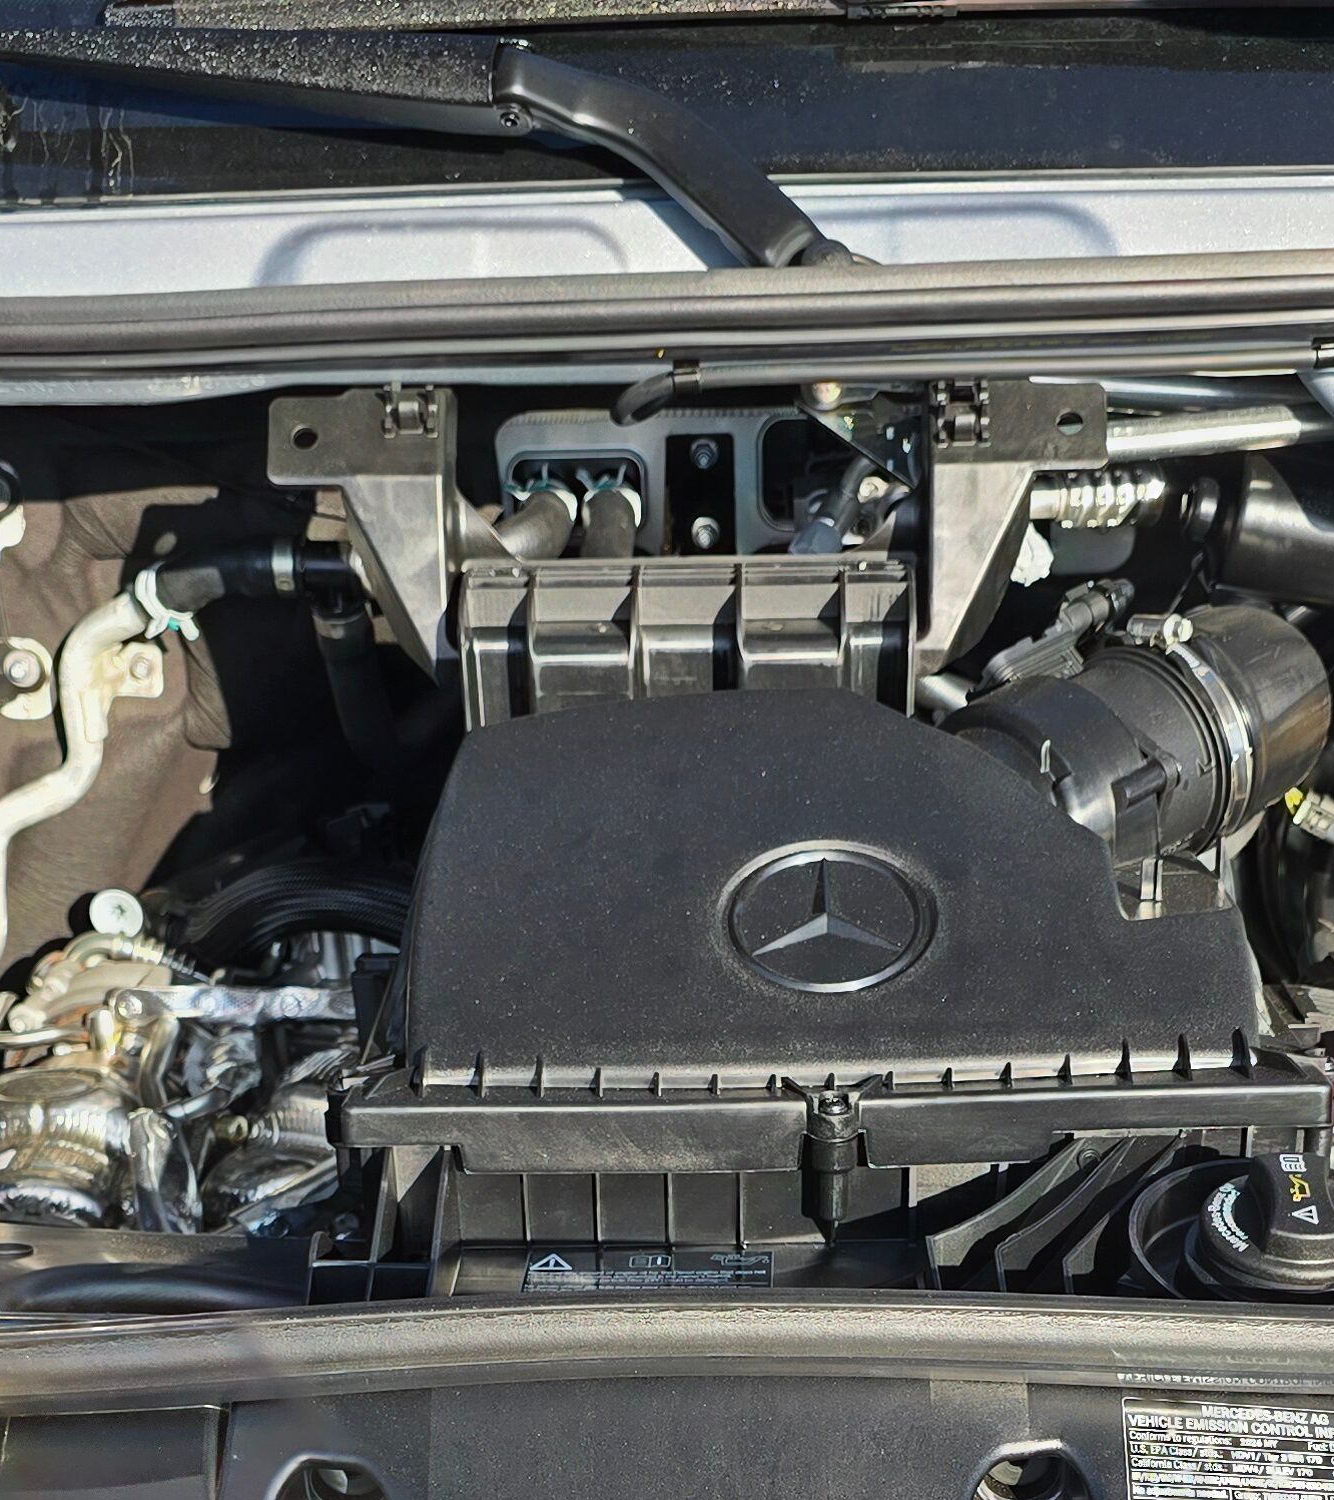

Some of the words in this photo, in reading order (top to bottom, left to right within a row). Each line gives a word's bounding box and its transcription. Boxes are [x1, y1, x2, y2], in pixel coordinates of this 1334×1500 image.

[1201, 1405, 1308, 1423] MERCEDES-BENZ
[1310, 1413, 1329, 1425] AG
[1128, 1414, 1182, 1428] VEHICLE
[1185, 1418, 1248, 1433] EMISSION
[1251, 1422, 1313, 1437] CONTROL
[1129, 1431, 1172, 1442] Conforms
[1173, 1434, 1180, 1442] to
[1150, 1445, 1168, 1455] EPA
